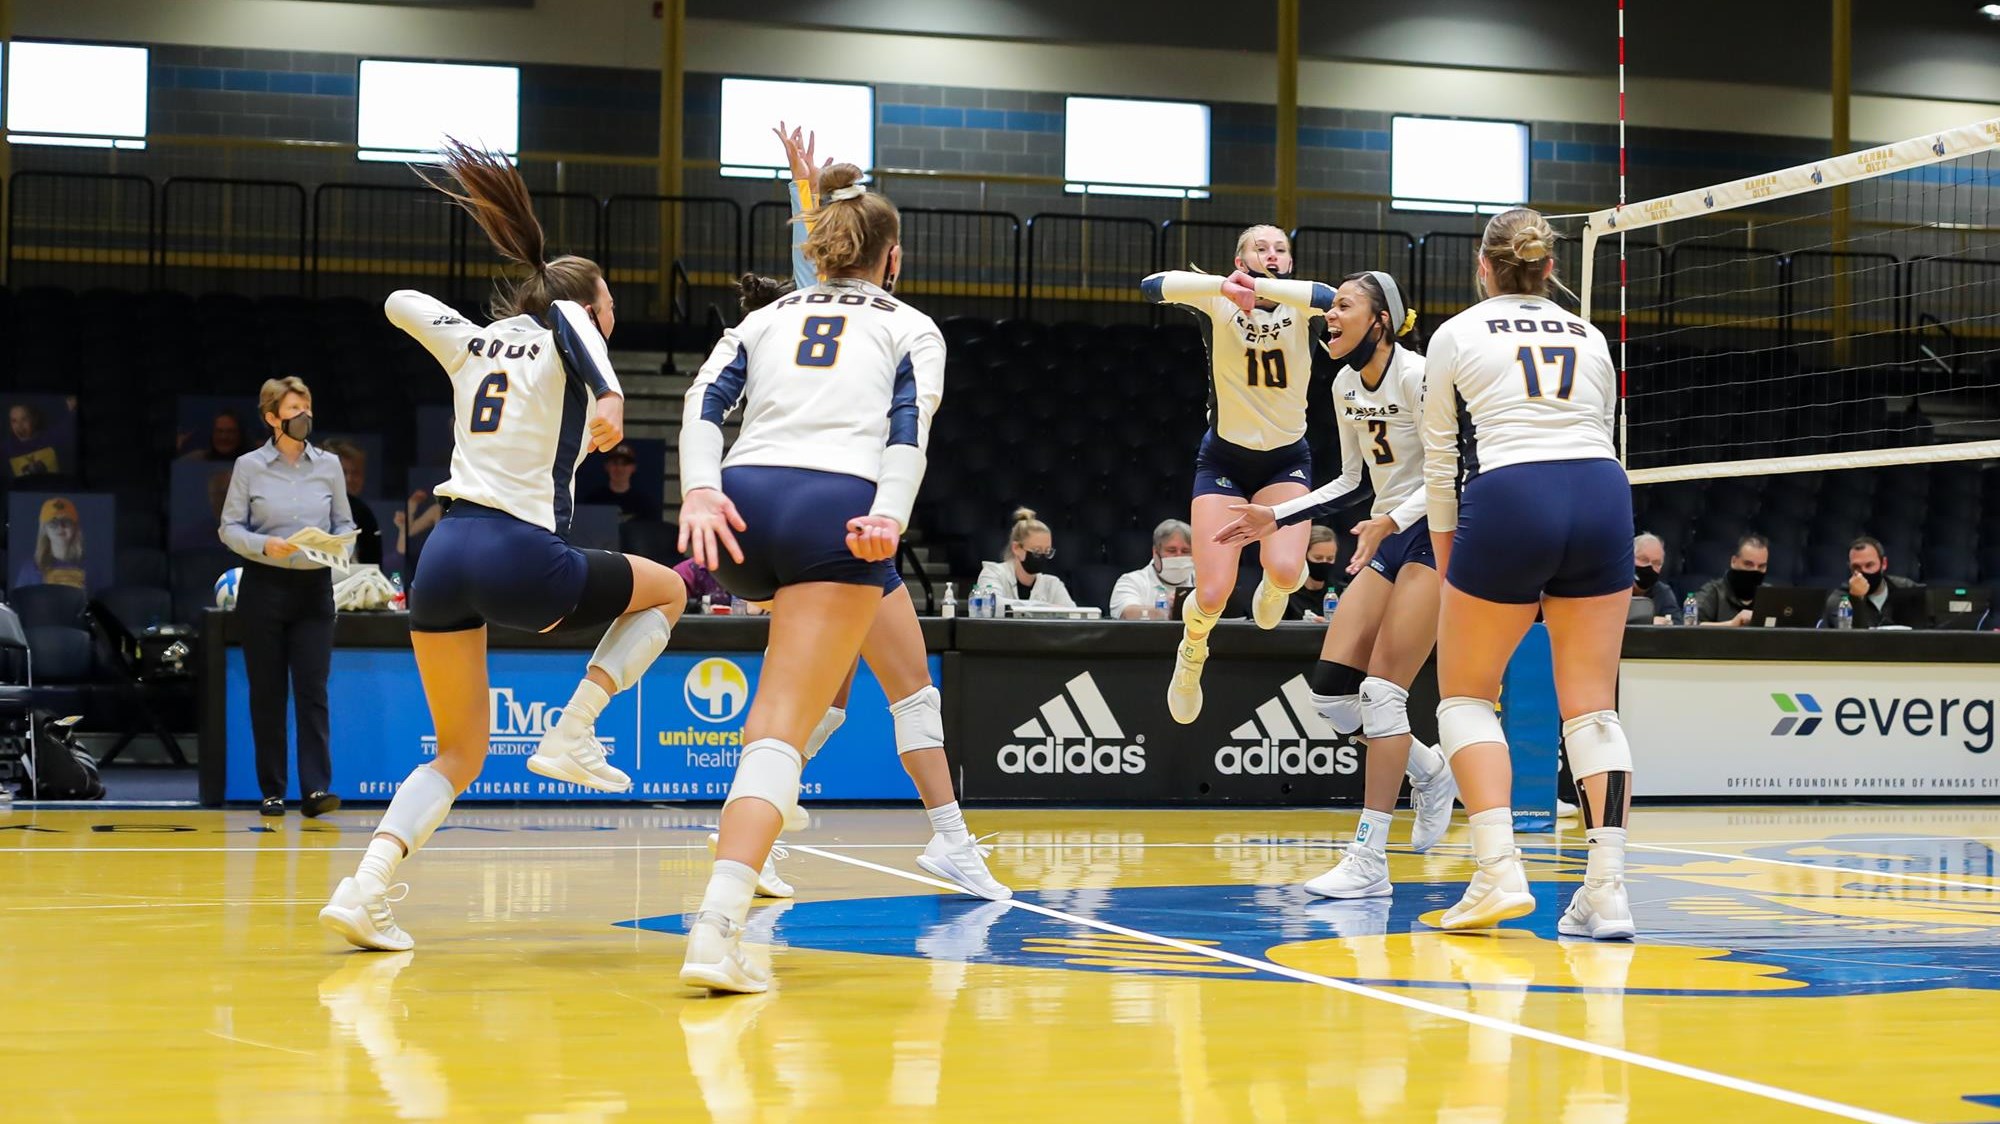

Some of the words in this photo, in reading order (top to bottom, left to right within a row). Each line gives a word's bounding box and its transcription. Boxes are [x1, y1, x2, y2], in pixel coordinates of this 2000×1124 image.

[776, 293, 899, 312] ROOS
[795, 315, 848, 369] 8
[1236, 316, 1292, 333] KASAS
[1485, 319, 1587, 338] ROOS
[1245, 347, 1288, 389] 10
[1515, 345, 1577, 400] 17
[470, 370, 509, 435] 6
[1368, 419, 1395, 466] 3
[658, 727, 744, 746] universi
[1835, 697, 1995, 753] everg
[488, 744, 538, 756] MEDICA
[997, 737, 1146, 775] adidas
[1215, 739, 1359, 776] adidas
[466, 782, 530, 794] LTHCARE
[643, 782, 699, 794] KANSAS
[706, 782, 730, 794] CIT
[1727, 778, 1782, 788] OFFICIAL
[1788, 778, 1848, 788] FOUNDING
[1854, 778, 1906, 788] PARTNER
[1912, 778, 1925, 788] OF
[1931, 778, 1976, 788] KANSAS
